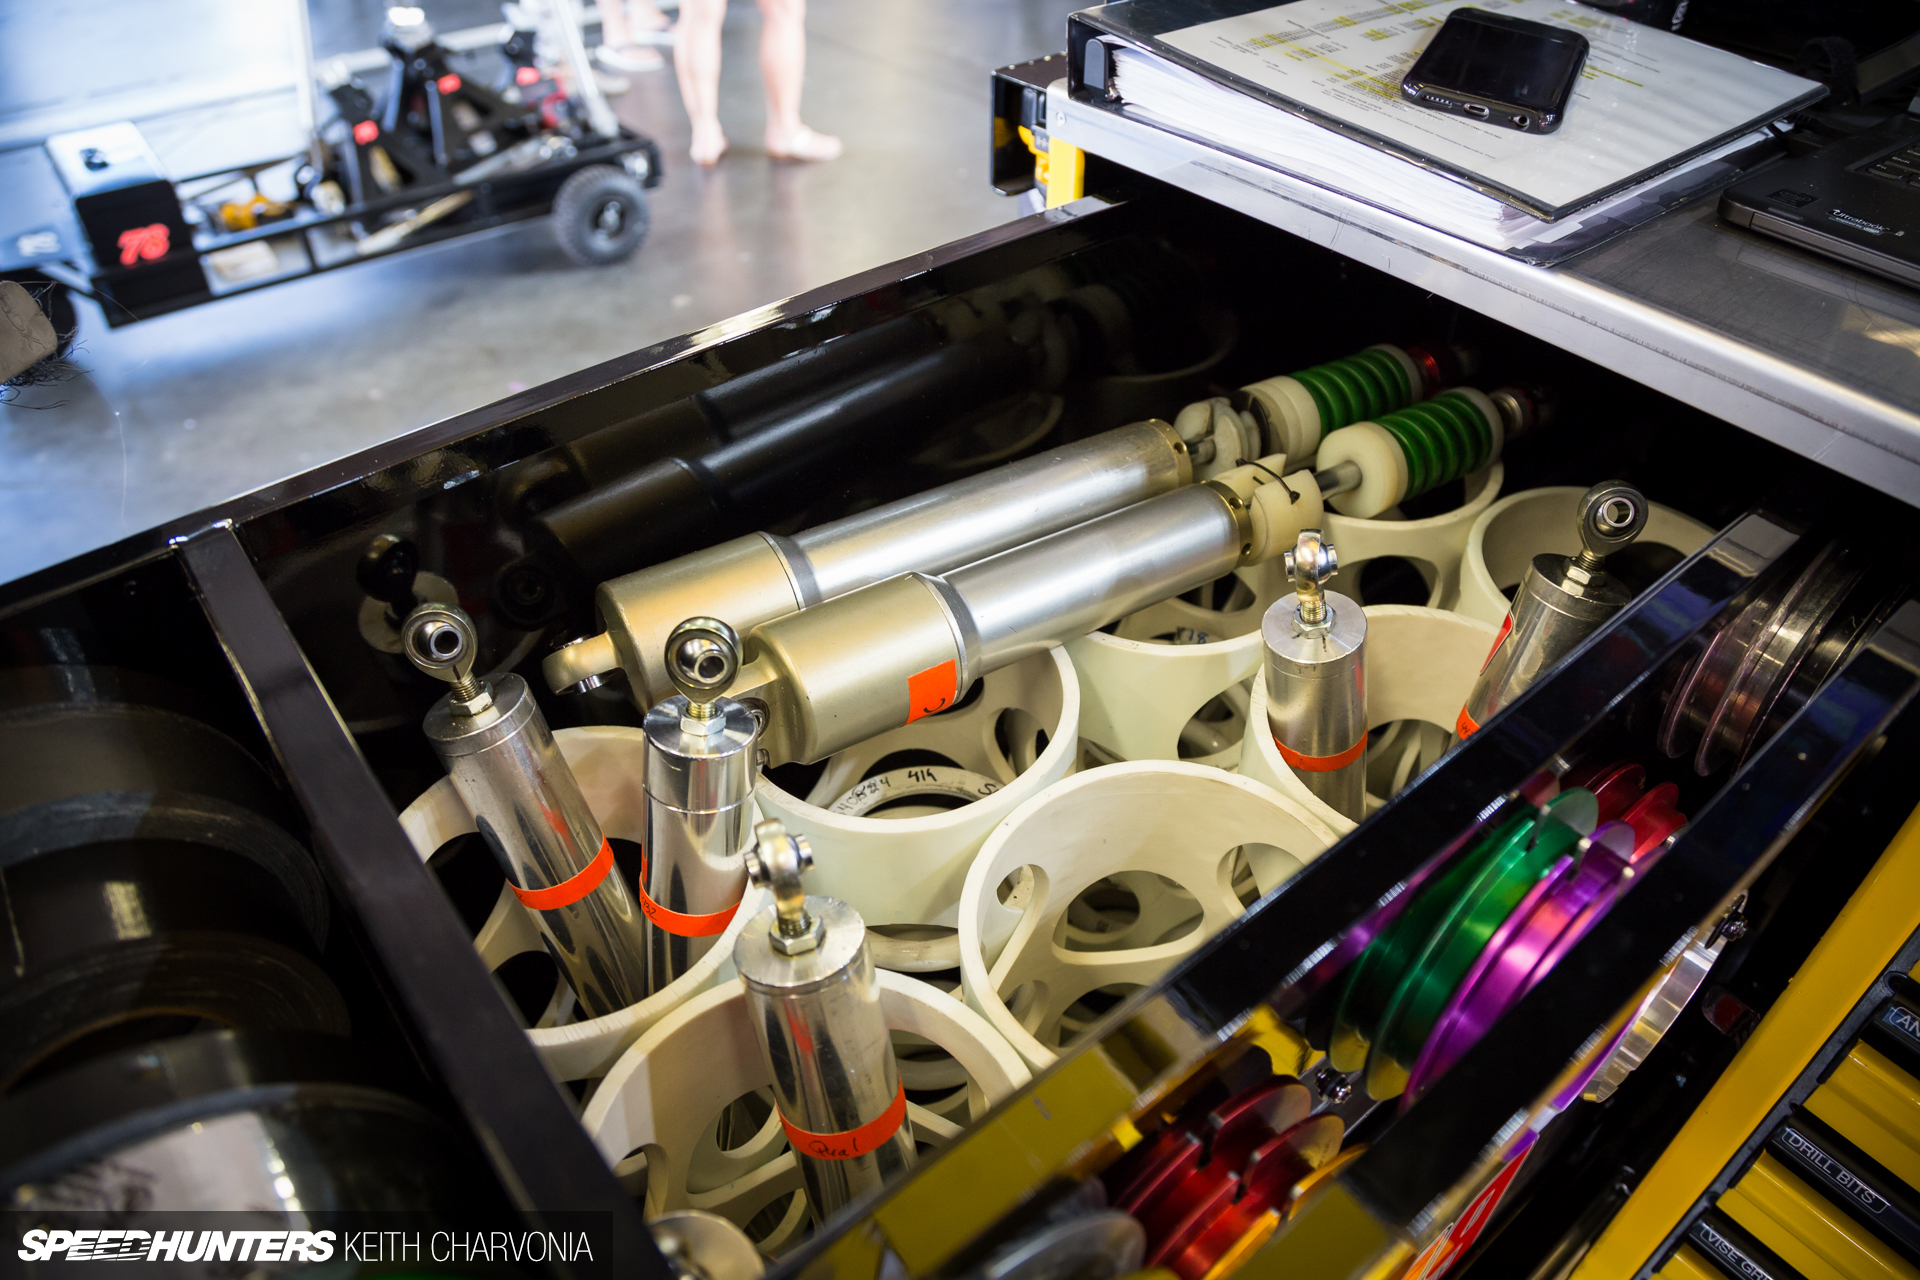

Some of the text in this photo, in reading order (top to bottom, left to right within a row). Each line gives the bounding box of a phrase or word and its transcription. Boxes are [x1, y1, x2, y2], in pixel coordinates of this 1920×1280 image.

[1833, 208, 1886, 231] Ultrabook
[1788, 1134, 1876, 1204] DRILL BITS
[1708, 1230, 1739, 1263] VISE
